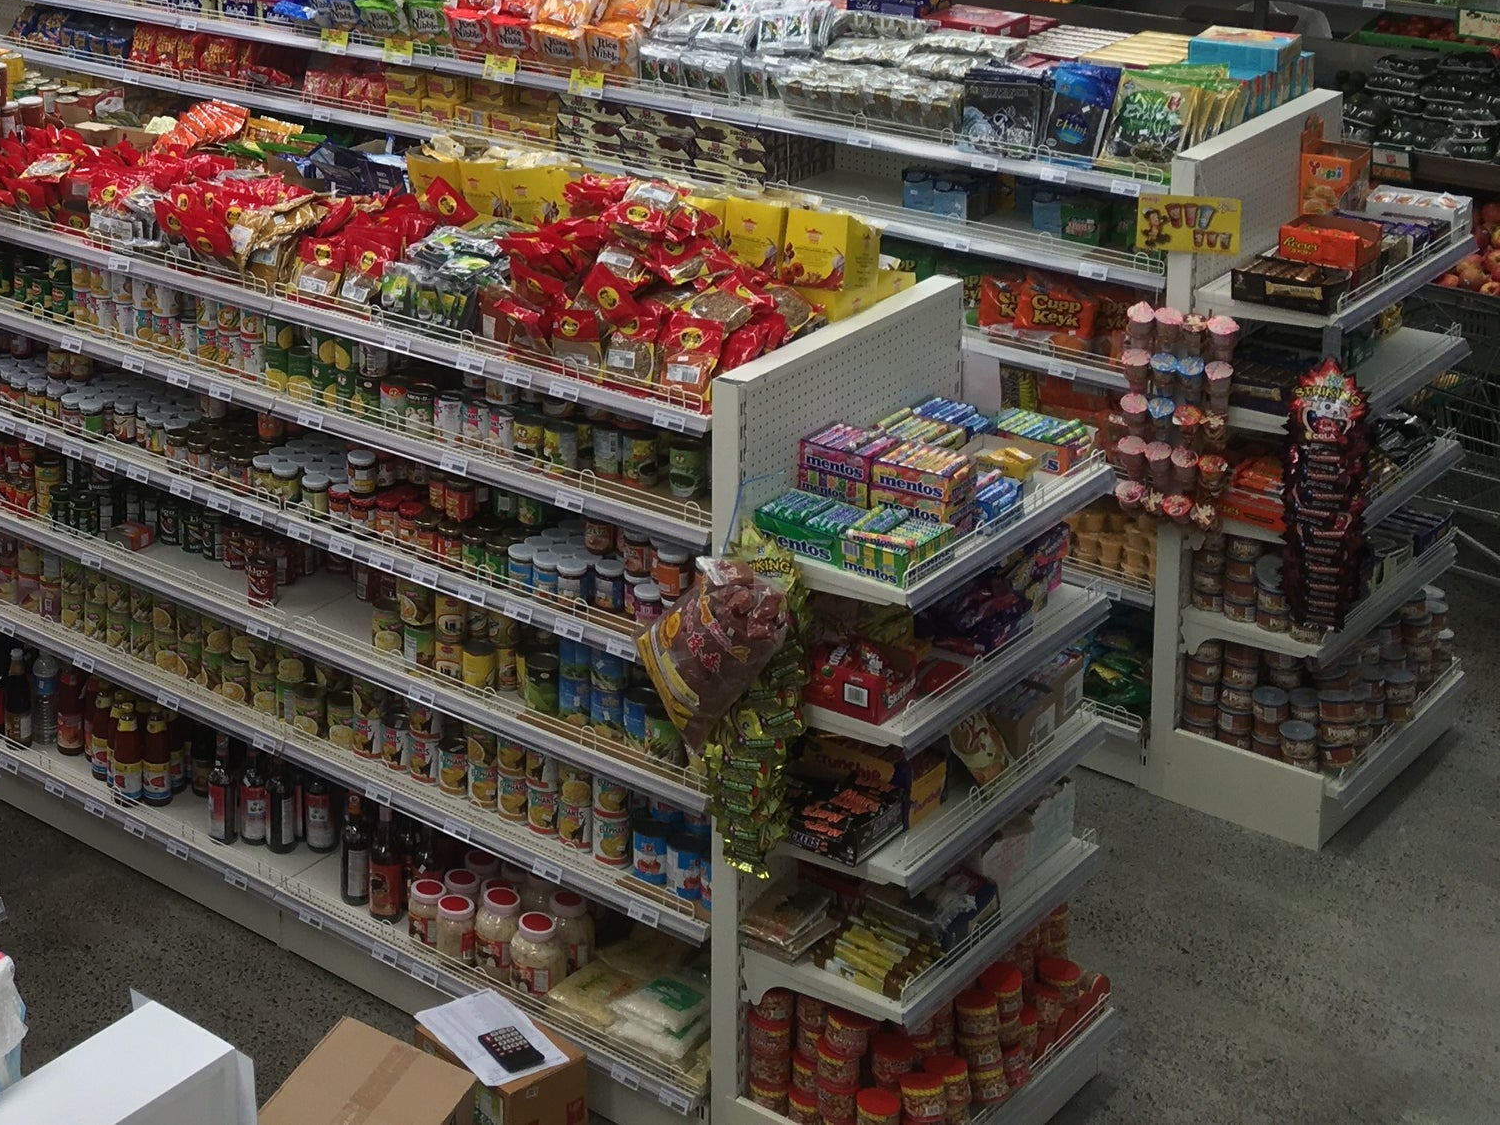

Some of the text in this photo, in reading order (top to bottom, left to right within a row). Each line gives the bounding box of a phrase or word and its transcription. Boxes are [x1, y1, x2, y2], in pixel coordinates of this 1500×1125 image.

[334, 1, 350, 11] Rice
[417, 10, 436, 20] Rice
[370, 12, 390, 21] Rice
[458, 20, 476, 29] Rice
[503, 26, 521, 37] Rice
[549, 37, 568, 47] Rice
[599, 38, 618, 50] Rice
[1308, 159, 1343, 181] Yupi
[1031, 294, 1082, 314] Cupp
[1032, 309, 1080, 327] Keyk
[1294, 385, 1362, 406] STRIKING
[1312, 432, 1336, 441] COLA
[806, 454, 863, 480] mentos
[802, 481, 847, 503] mentos
[879, 474, 944, 499] mentos
[842, 559, 898, 586] mentos
[791, 831, 820, 849] CKERS
